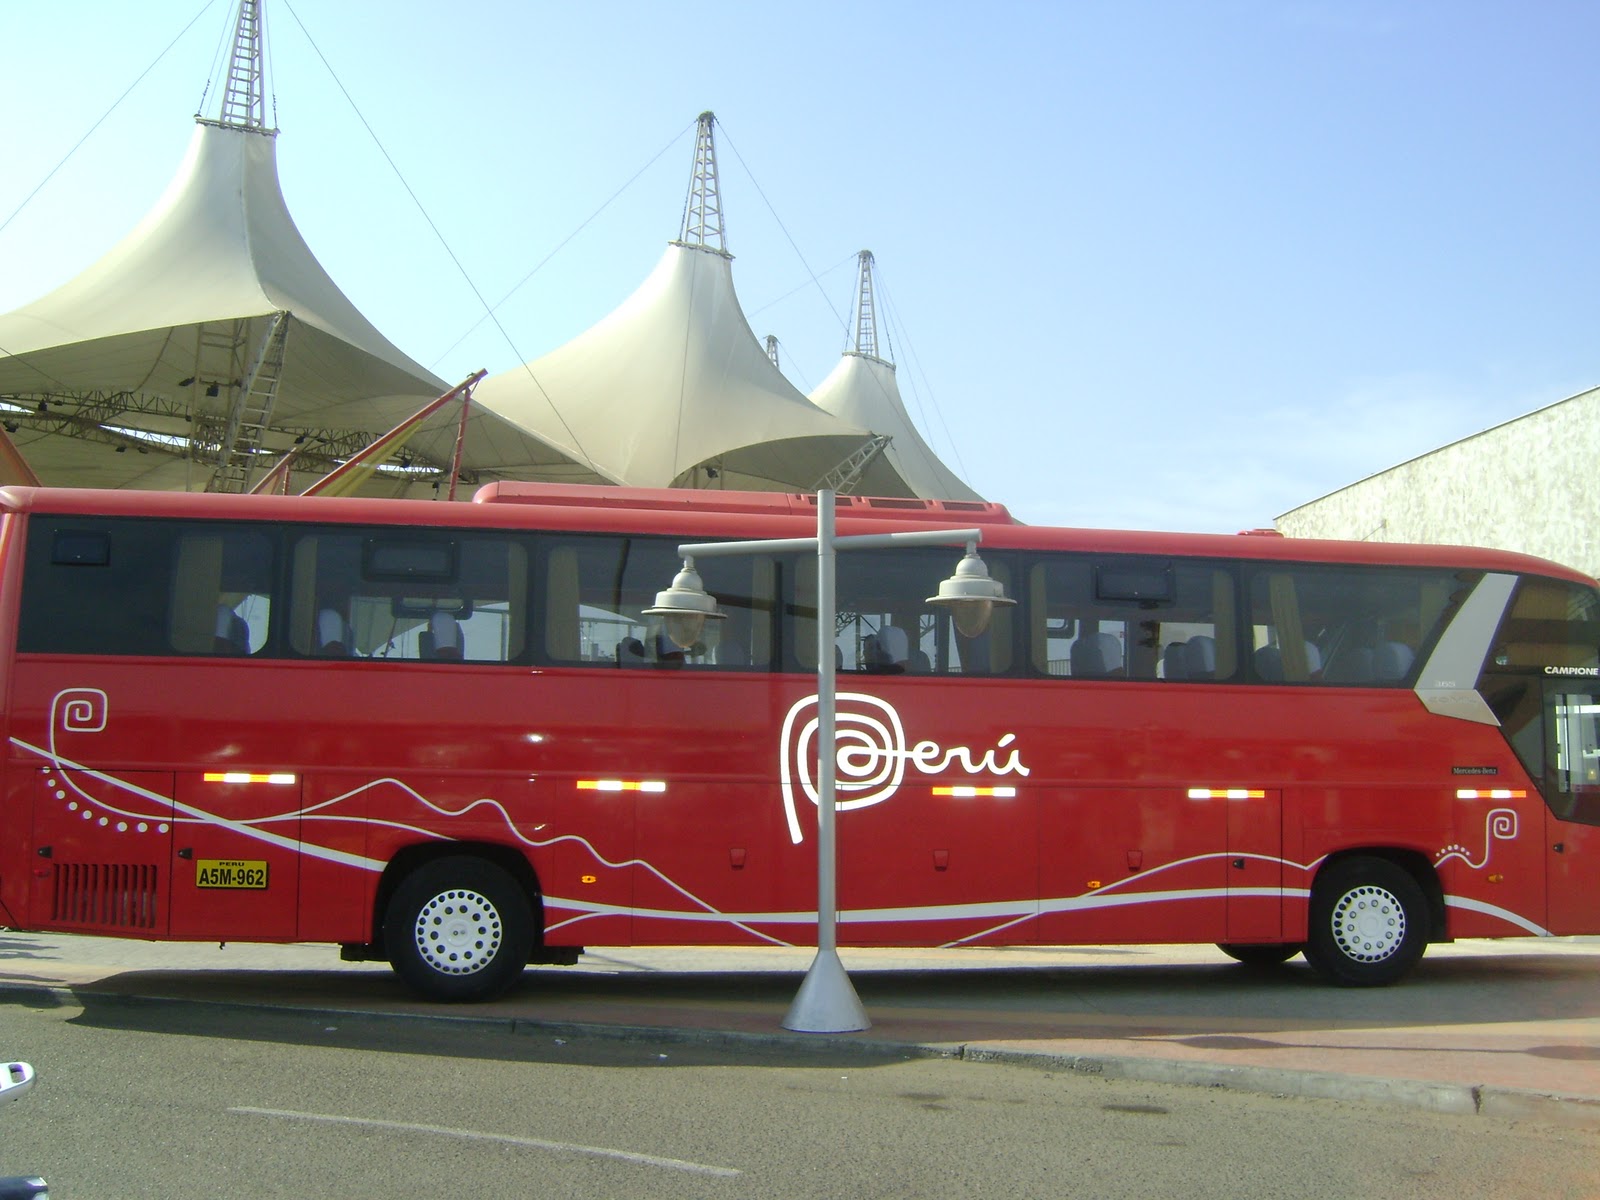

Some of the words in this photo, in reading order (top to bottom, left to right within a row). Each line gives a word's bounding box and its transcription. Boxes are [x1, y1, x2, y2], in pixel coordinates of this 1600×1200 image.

[1544, 666, 1599, 676] CAMPIONE
[780, 692, 1030, 844] Perú
[1453, 767, 1497, 775] Mercedes-Benz
[199, 868, 265, 886] A5M-962
